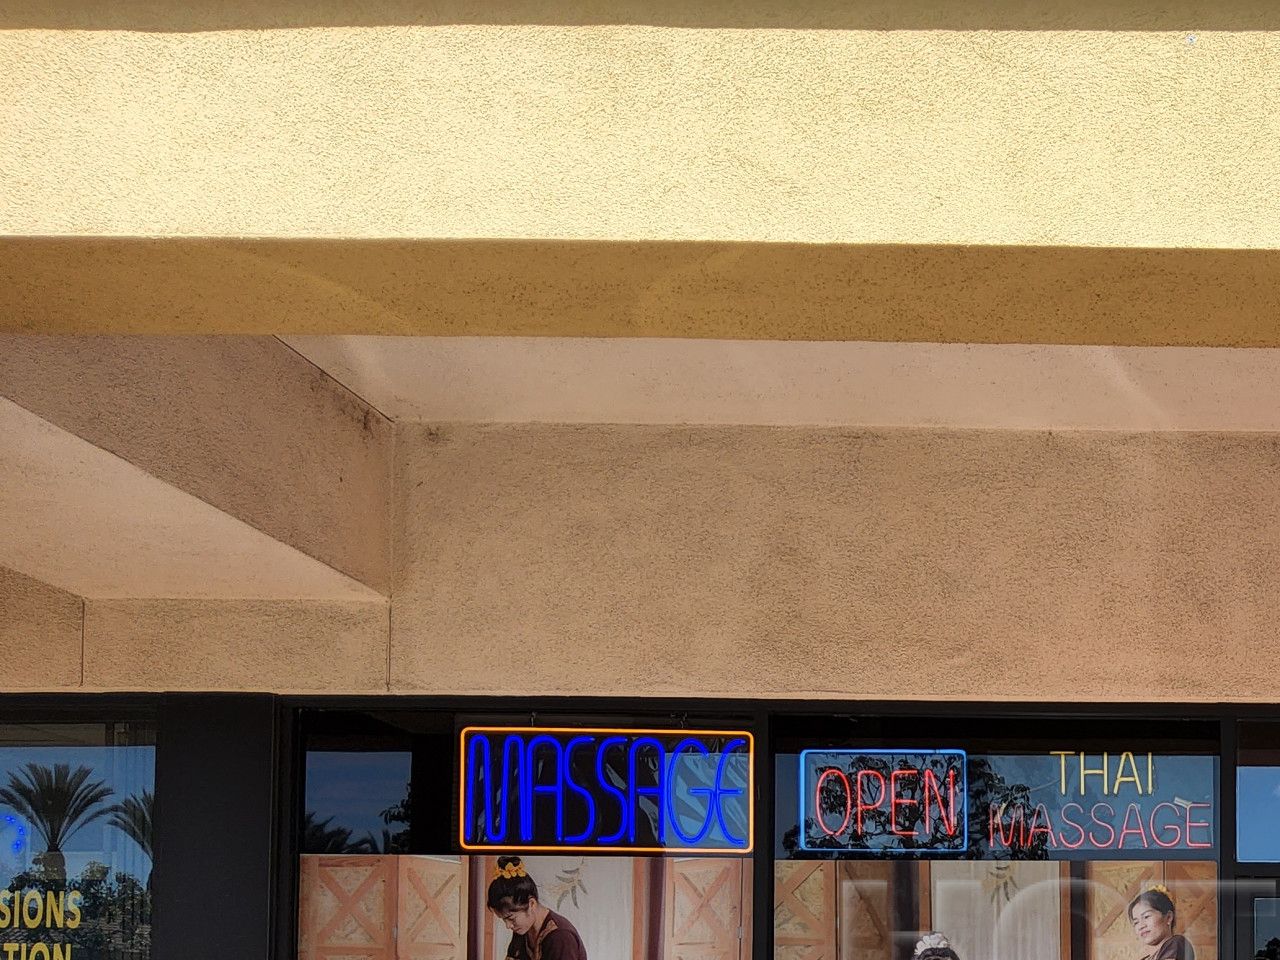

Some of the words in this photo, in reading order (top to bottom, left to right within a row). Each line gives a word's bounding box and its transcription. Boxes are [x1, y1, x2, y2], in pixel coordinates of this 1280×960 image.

[466, 734, 747, 845] MASSAGE
[1050, 750, 1154, 796] THAI
[815, 768, 957, 838] OPEN
[988, 801, 1213, 849] MASSAGE
